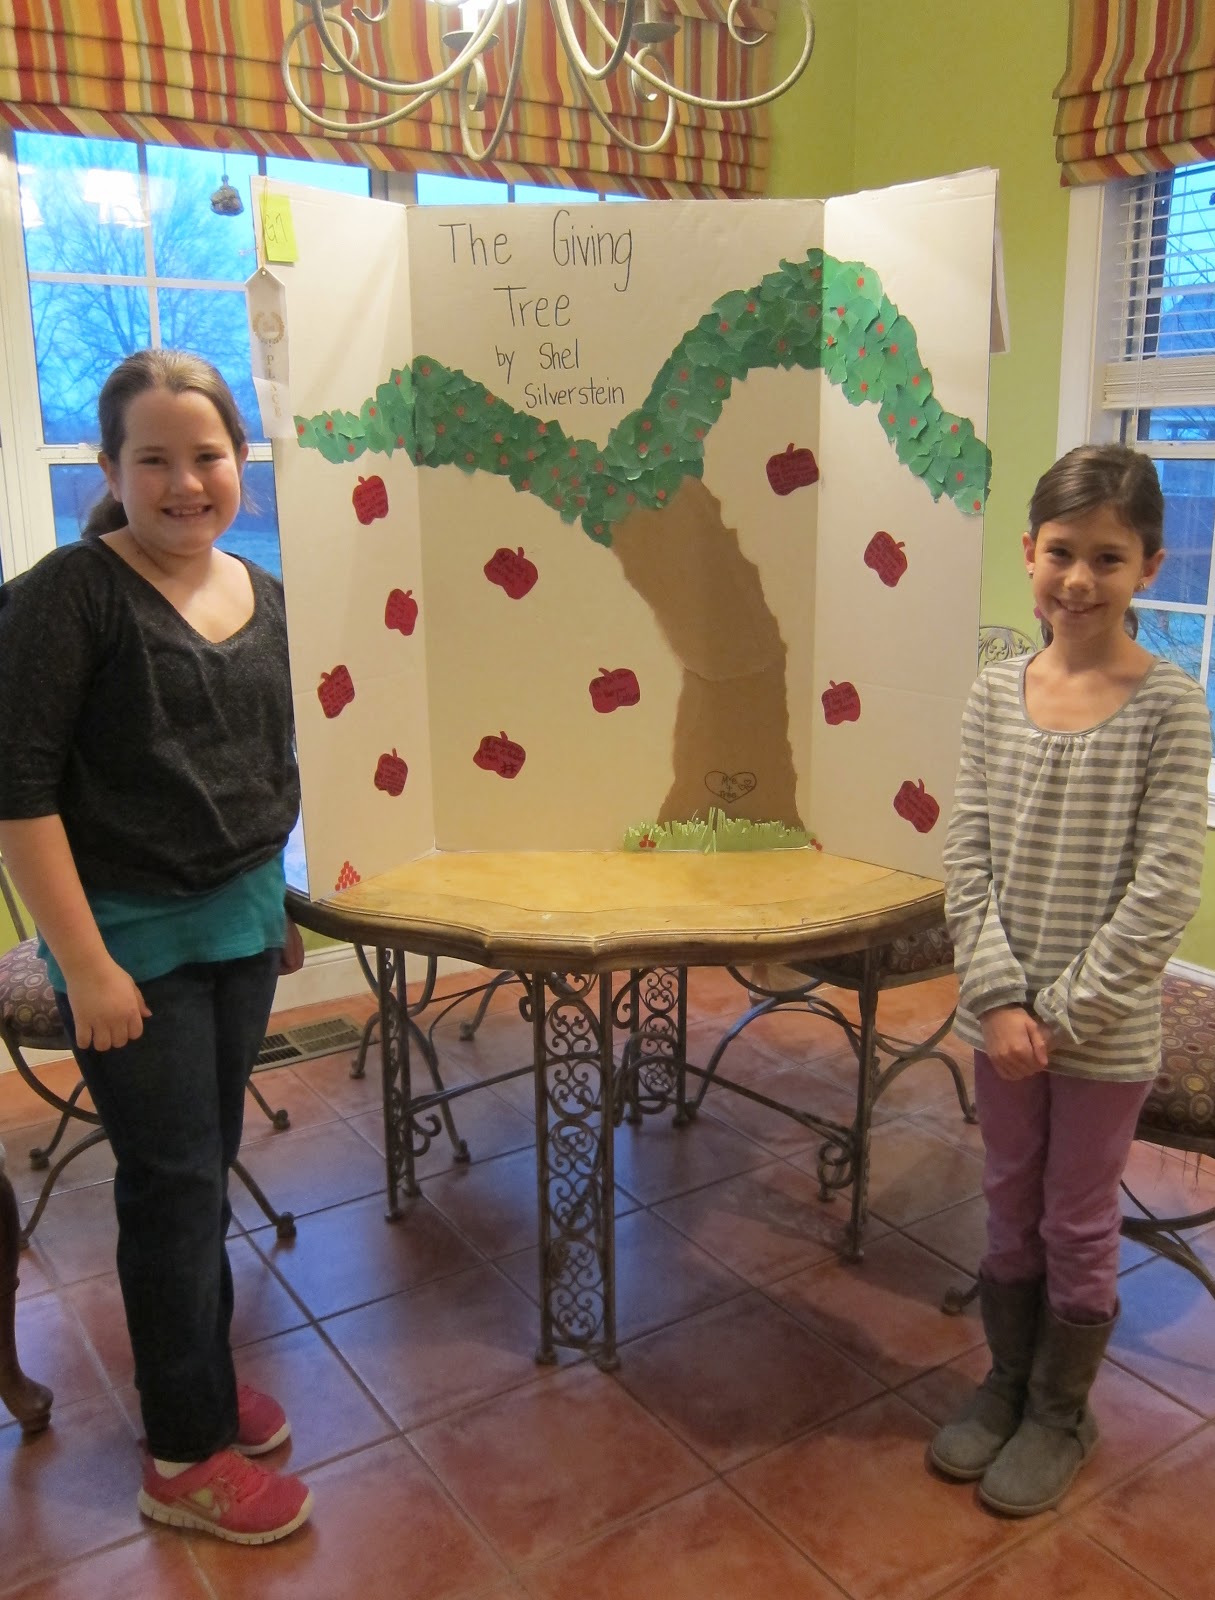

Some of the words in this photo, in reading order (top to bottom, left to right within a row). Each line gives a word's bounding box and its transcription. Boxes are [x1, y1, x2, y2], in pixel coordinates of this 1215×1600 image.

[438, 223, 512, 266] The
[552, 209, 633, 293] Giving
[493, 285, 571, 327] Tree
[495, 344, 515, 384] by
[539, 338, 580, 370] Shel
[524, 376, 625, 409] Silverstein
